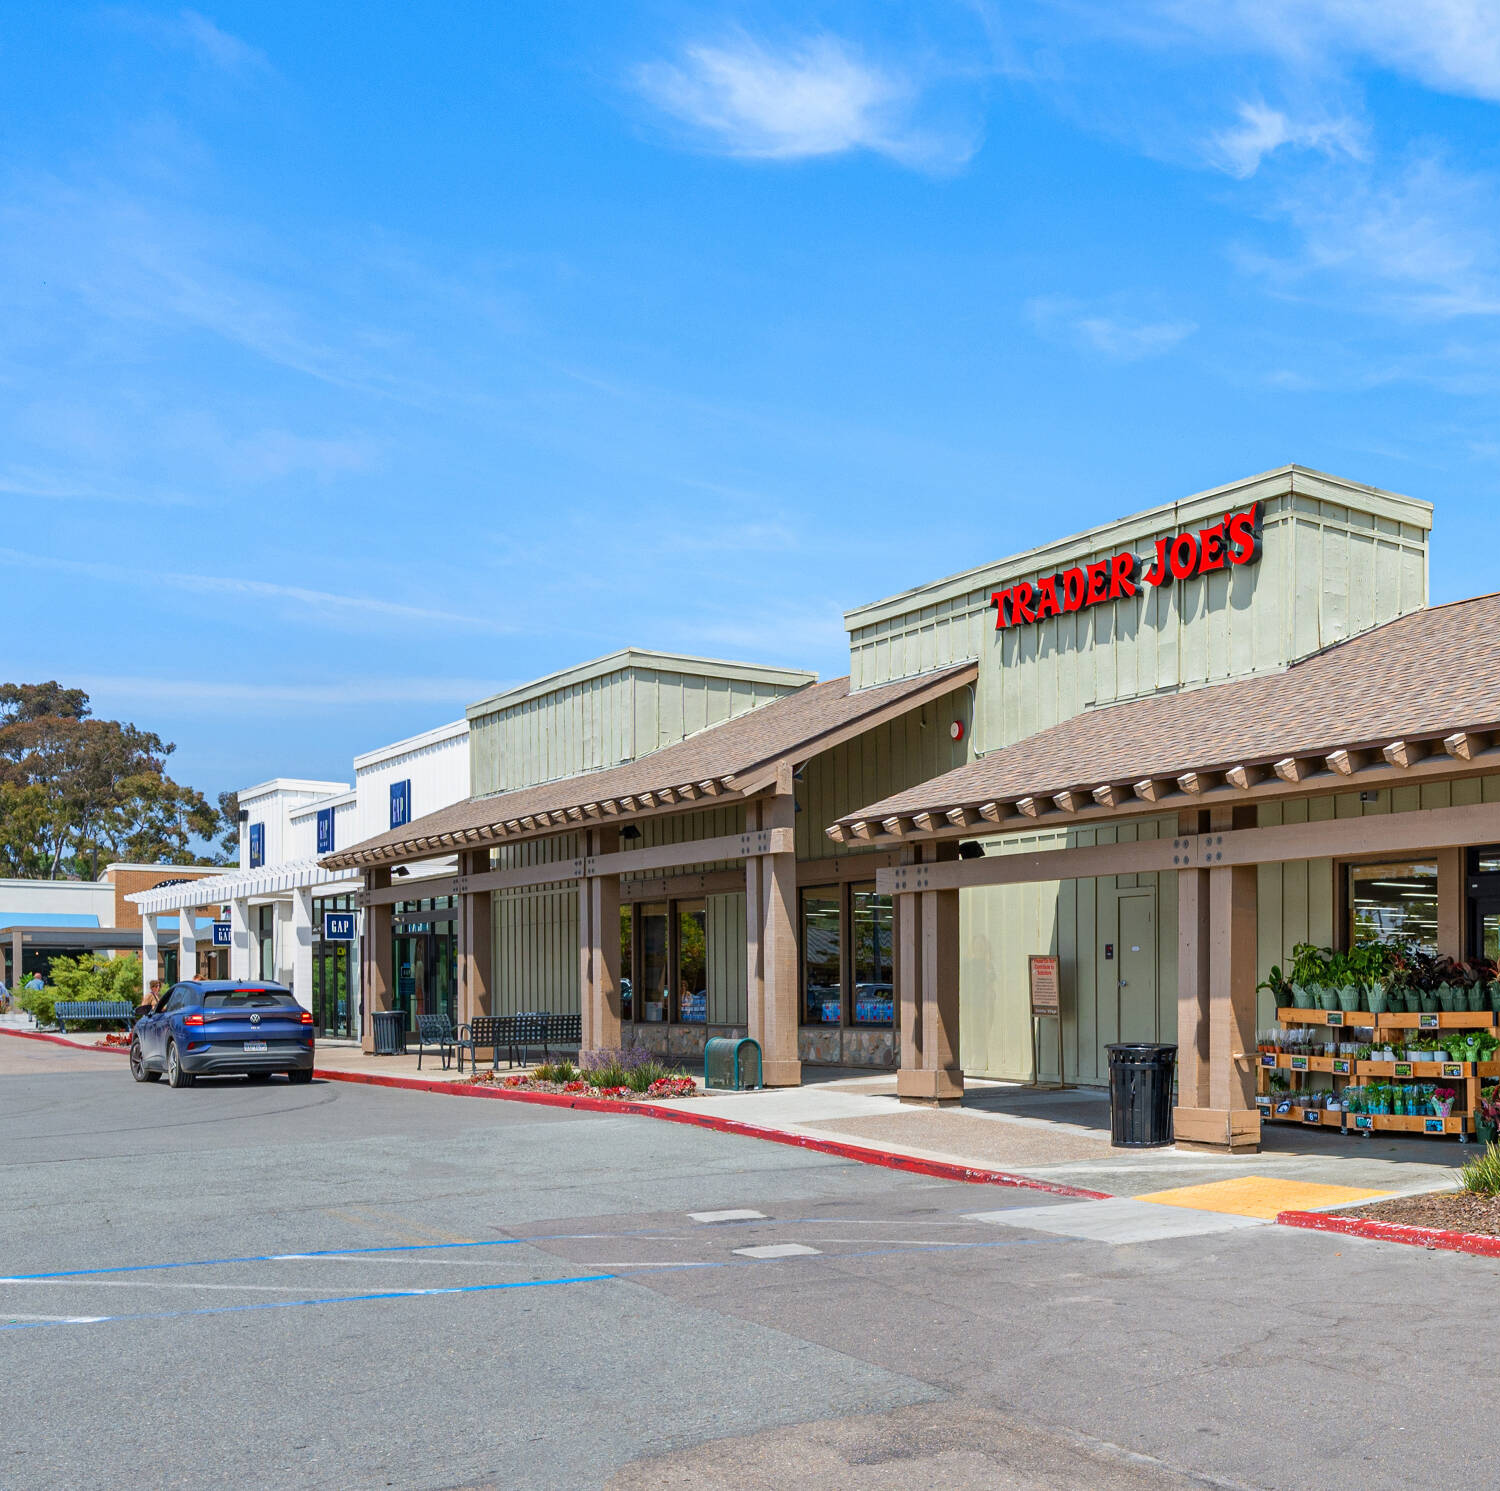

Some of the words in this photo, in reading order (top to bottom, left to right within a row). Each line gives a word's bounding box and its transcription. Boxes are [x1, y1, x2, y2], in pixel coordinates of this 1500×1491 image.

[989, 552, 1143, 631] TRADER
[1143, 502, 1260, 588] JOE'S
[331, 919, 349, 933] GAP
